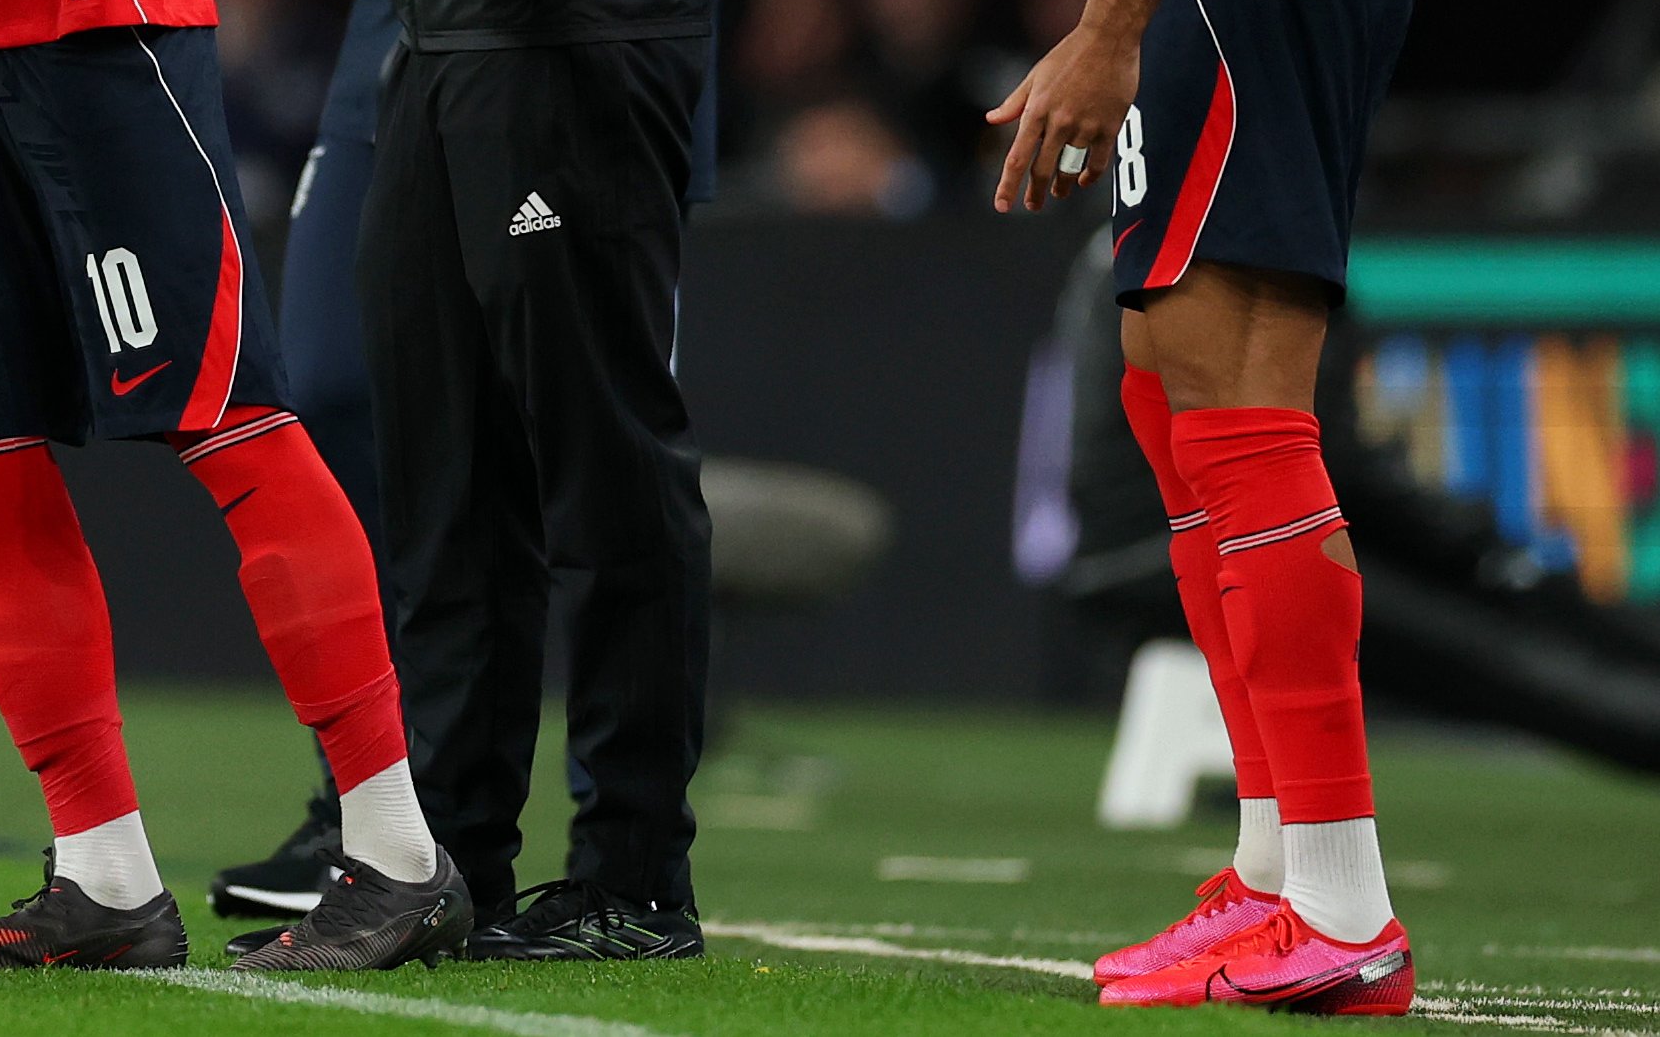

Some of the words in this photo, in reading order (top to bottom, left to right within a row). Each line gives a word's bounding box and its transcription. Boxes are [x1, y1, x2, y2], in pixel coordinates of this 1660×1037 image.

[1111, 103, 1148, 217] 8
[508, 215, 562, 237] adidas
[86, 246, 159, 354] 10
